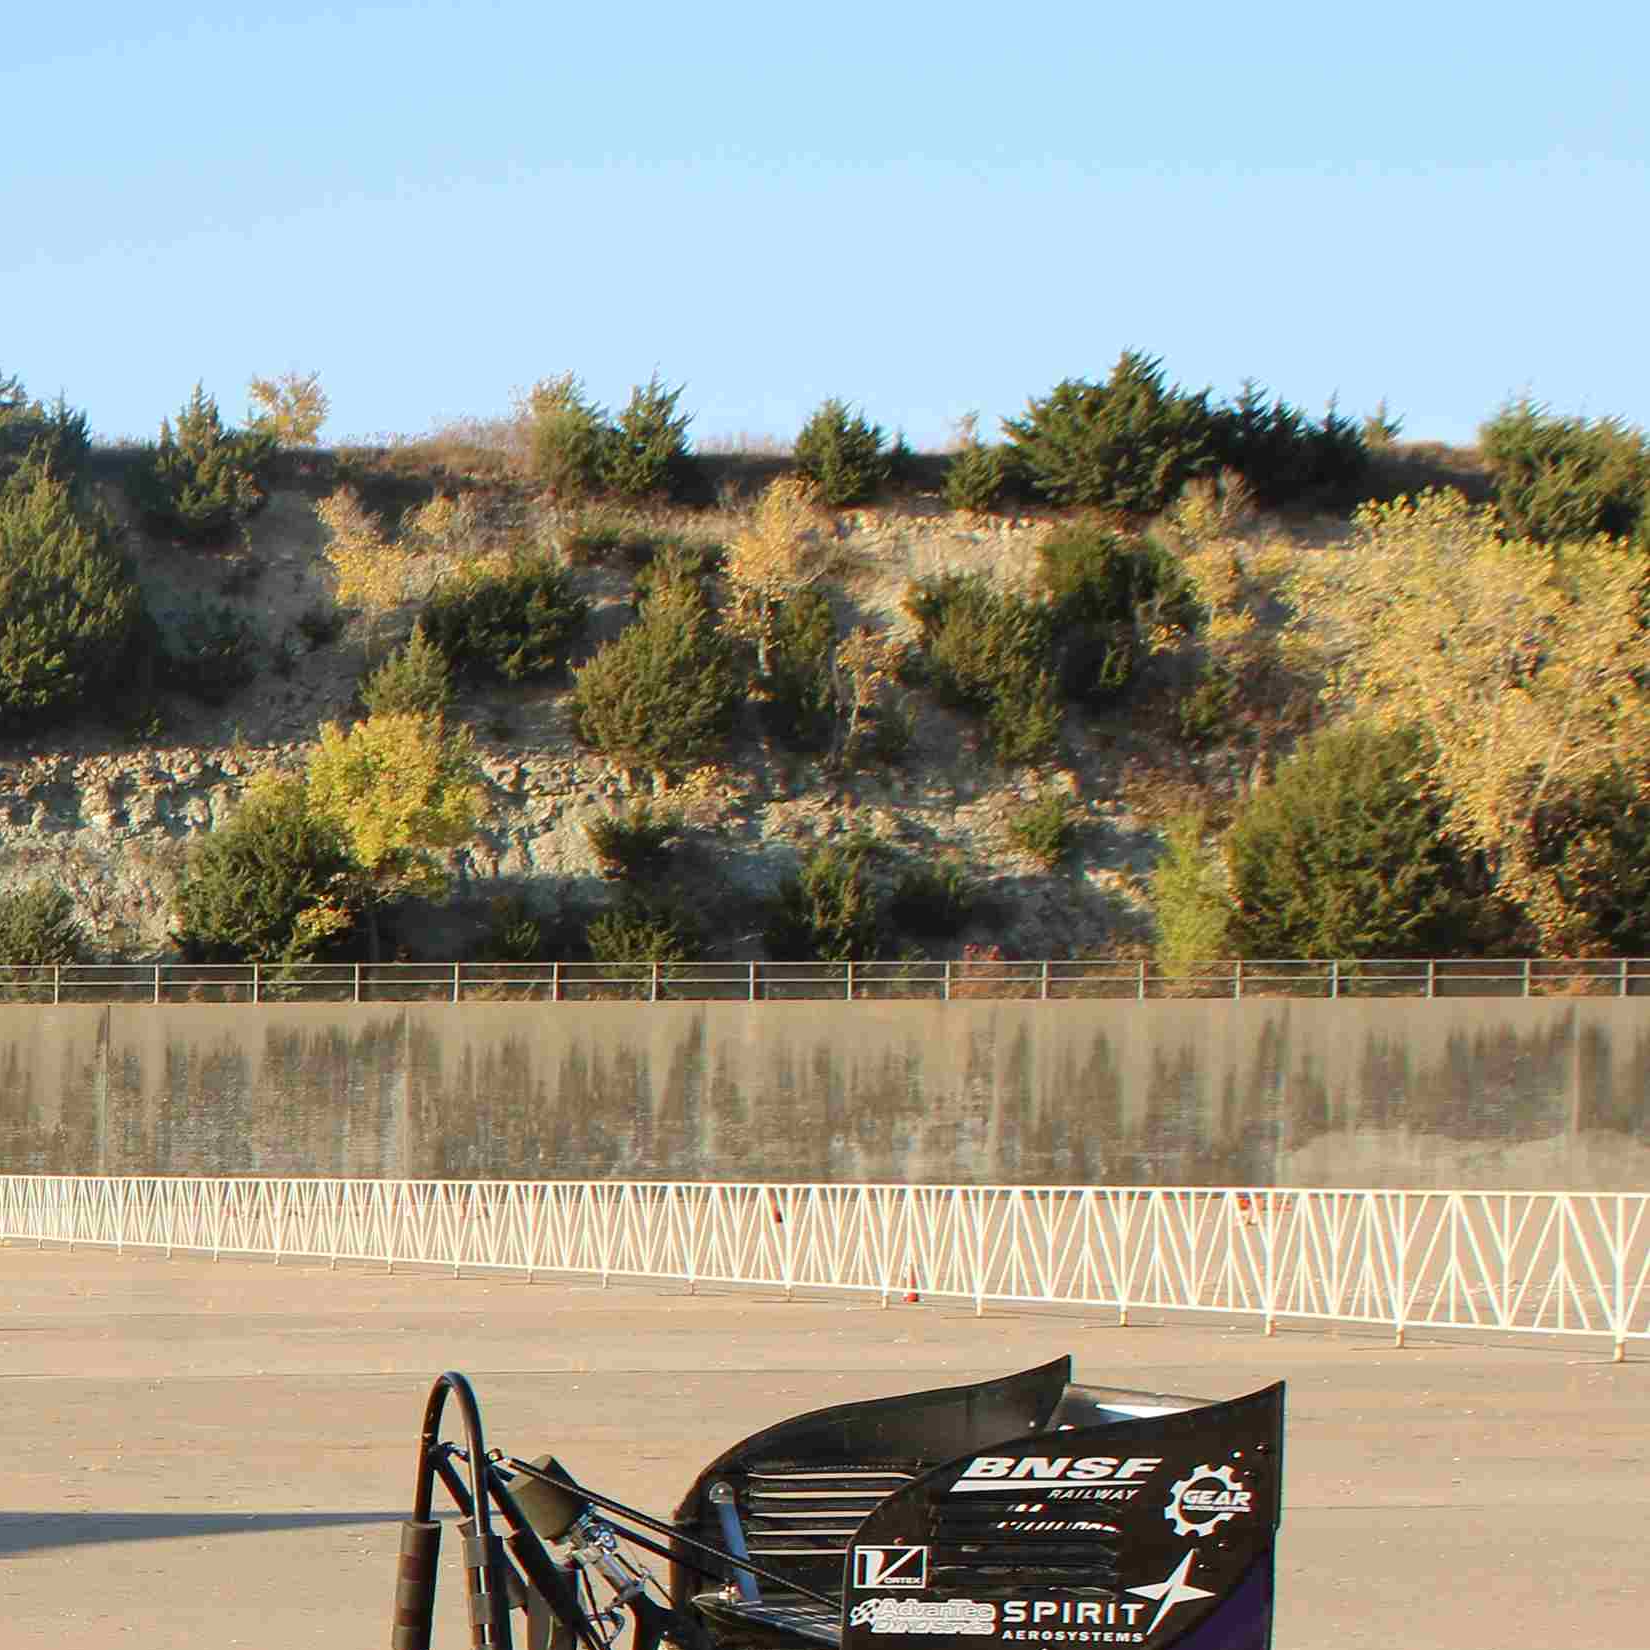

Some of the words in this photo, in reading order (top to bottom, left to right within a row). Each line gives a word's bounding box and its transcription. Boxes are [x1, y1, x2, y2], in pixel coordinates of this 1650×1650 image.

[962, 1456, 1163, 1479] BNSF
[1047, 1489, 1139, 1500] RAILWAY
[1182, 1489, 1252, 1507] GEAR
[1002, 1601, 1147, 1625] SPIRIT
[1002, 1630, 1145, 1643] AEROSYSTEMS
